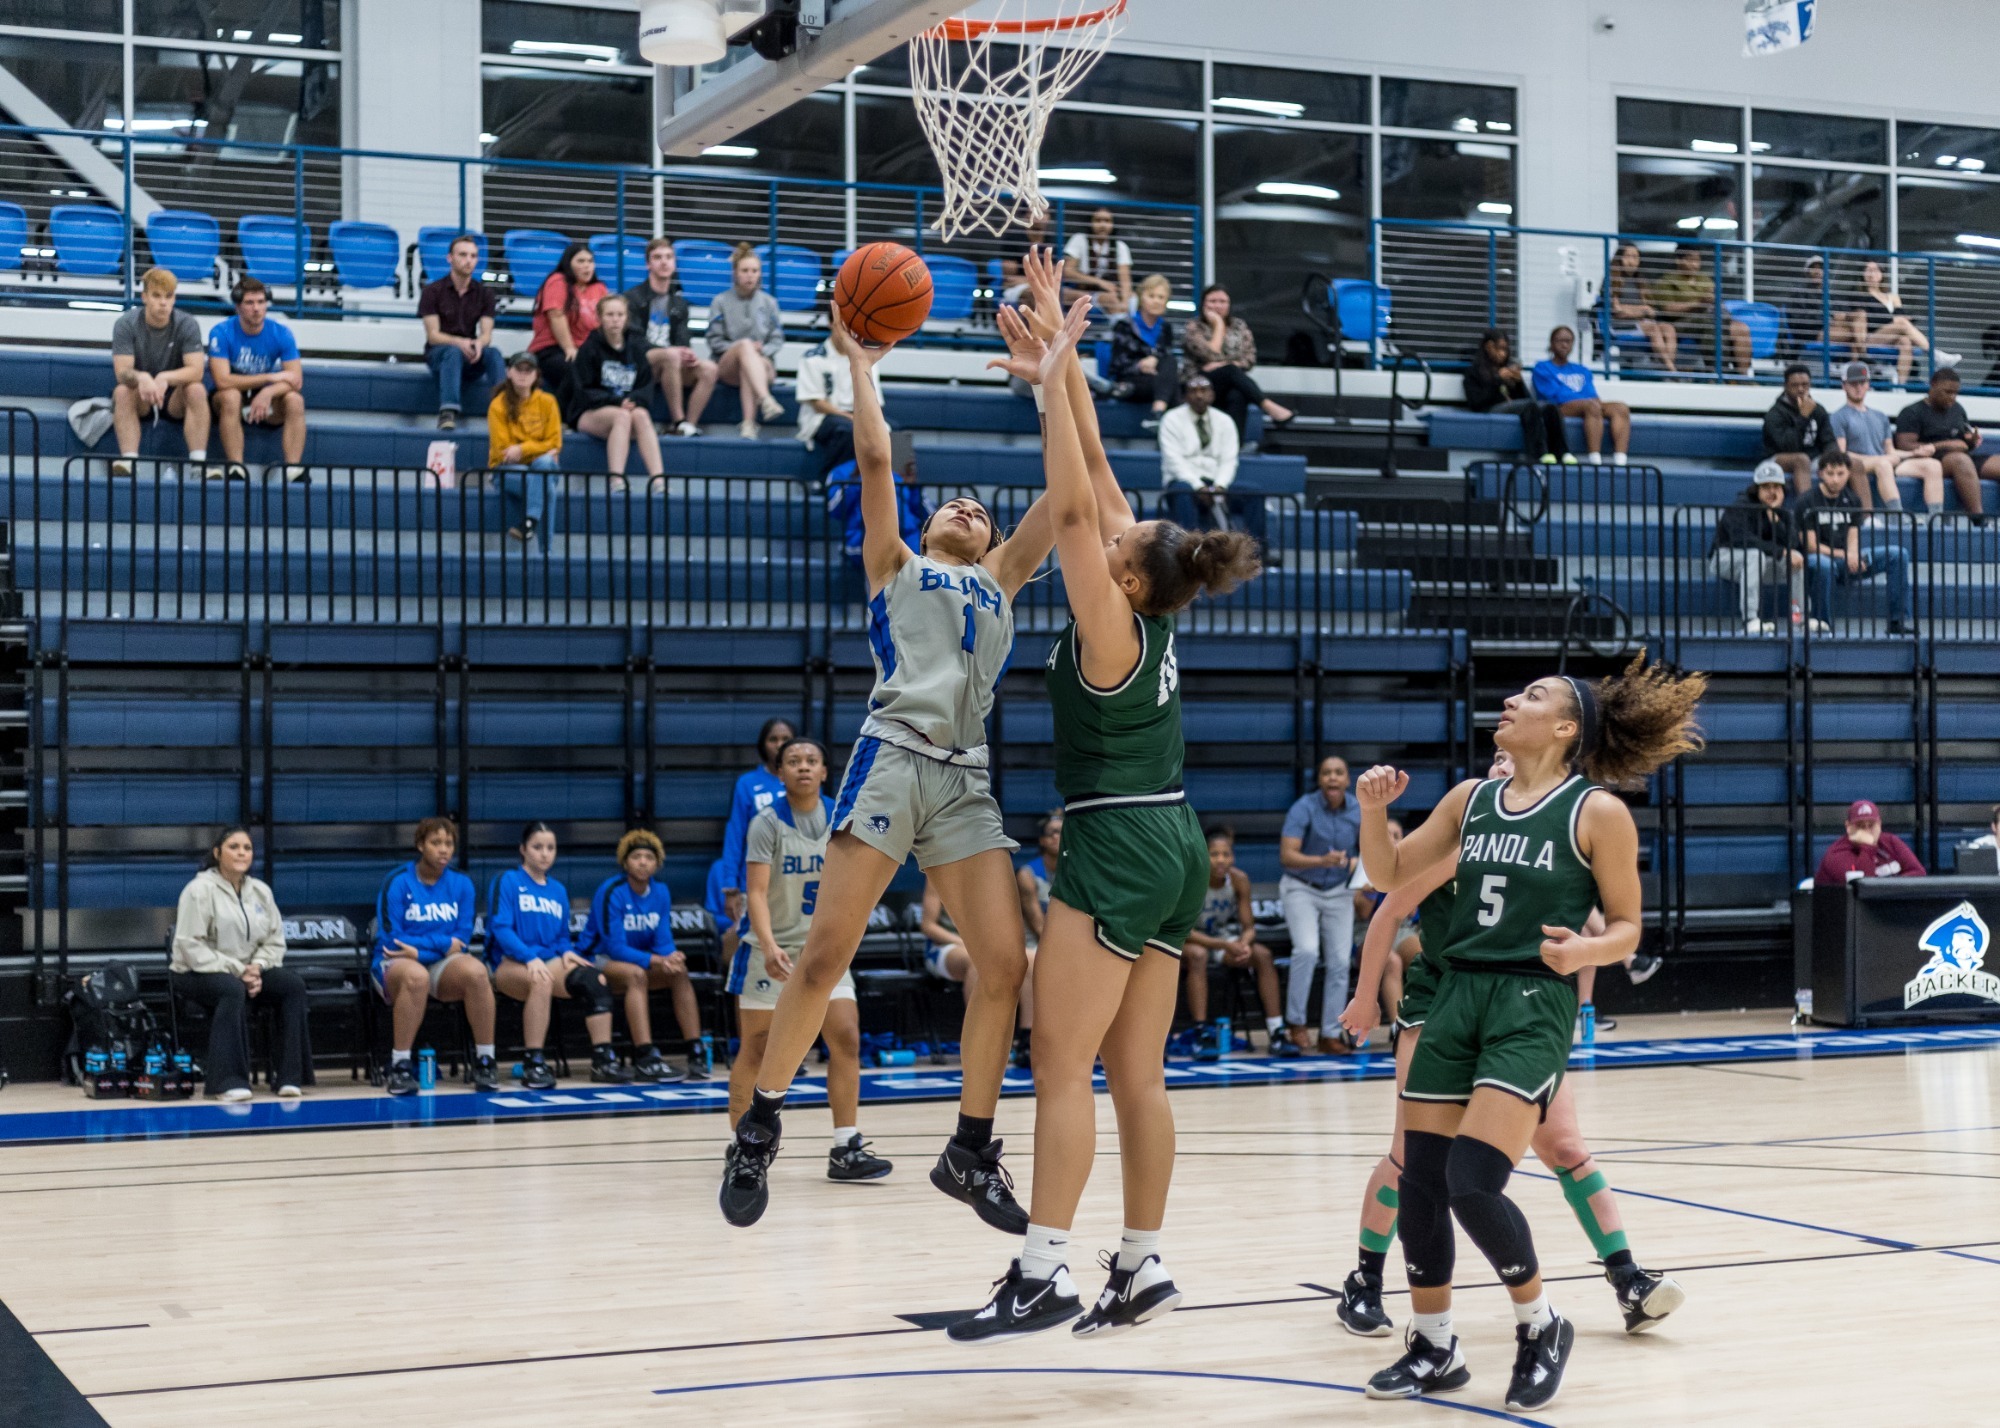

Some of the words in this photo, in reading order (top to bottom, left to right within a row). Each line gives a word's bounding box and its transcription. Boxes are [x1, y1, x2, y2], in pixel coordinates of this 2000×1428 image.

[919, 567, 1001, 619] BLINN
[961, 602, 976, 655] 1
[782, 854, 824, 875] BLIN
[1459, 832, 1554, 871] PANOLA
[405, 902, 458, 922] BLINN
[802, 881, 820, 915] 5
[1477, 874, 1507, 927] 5
[283, 919, 346, 940] BLINN
